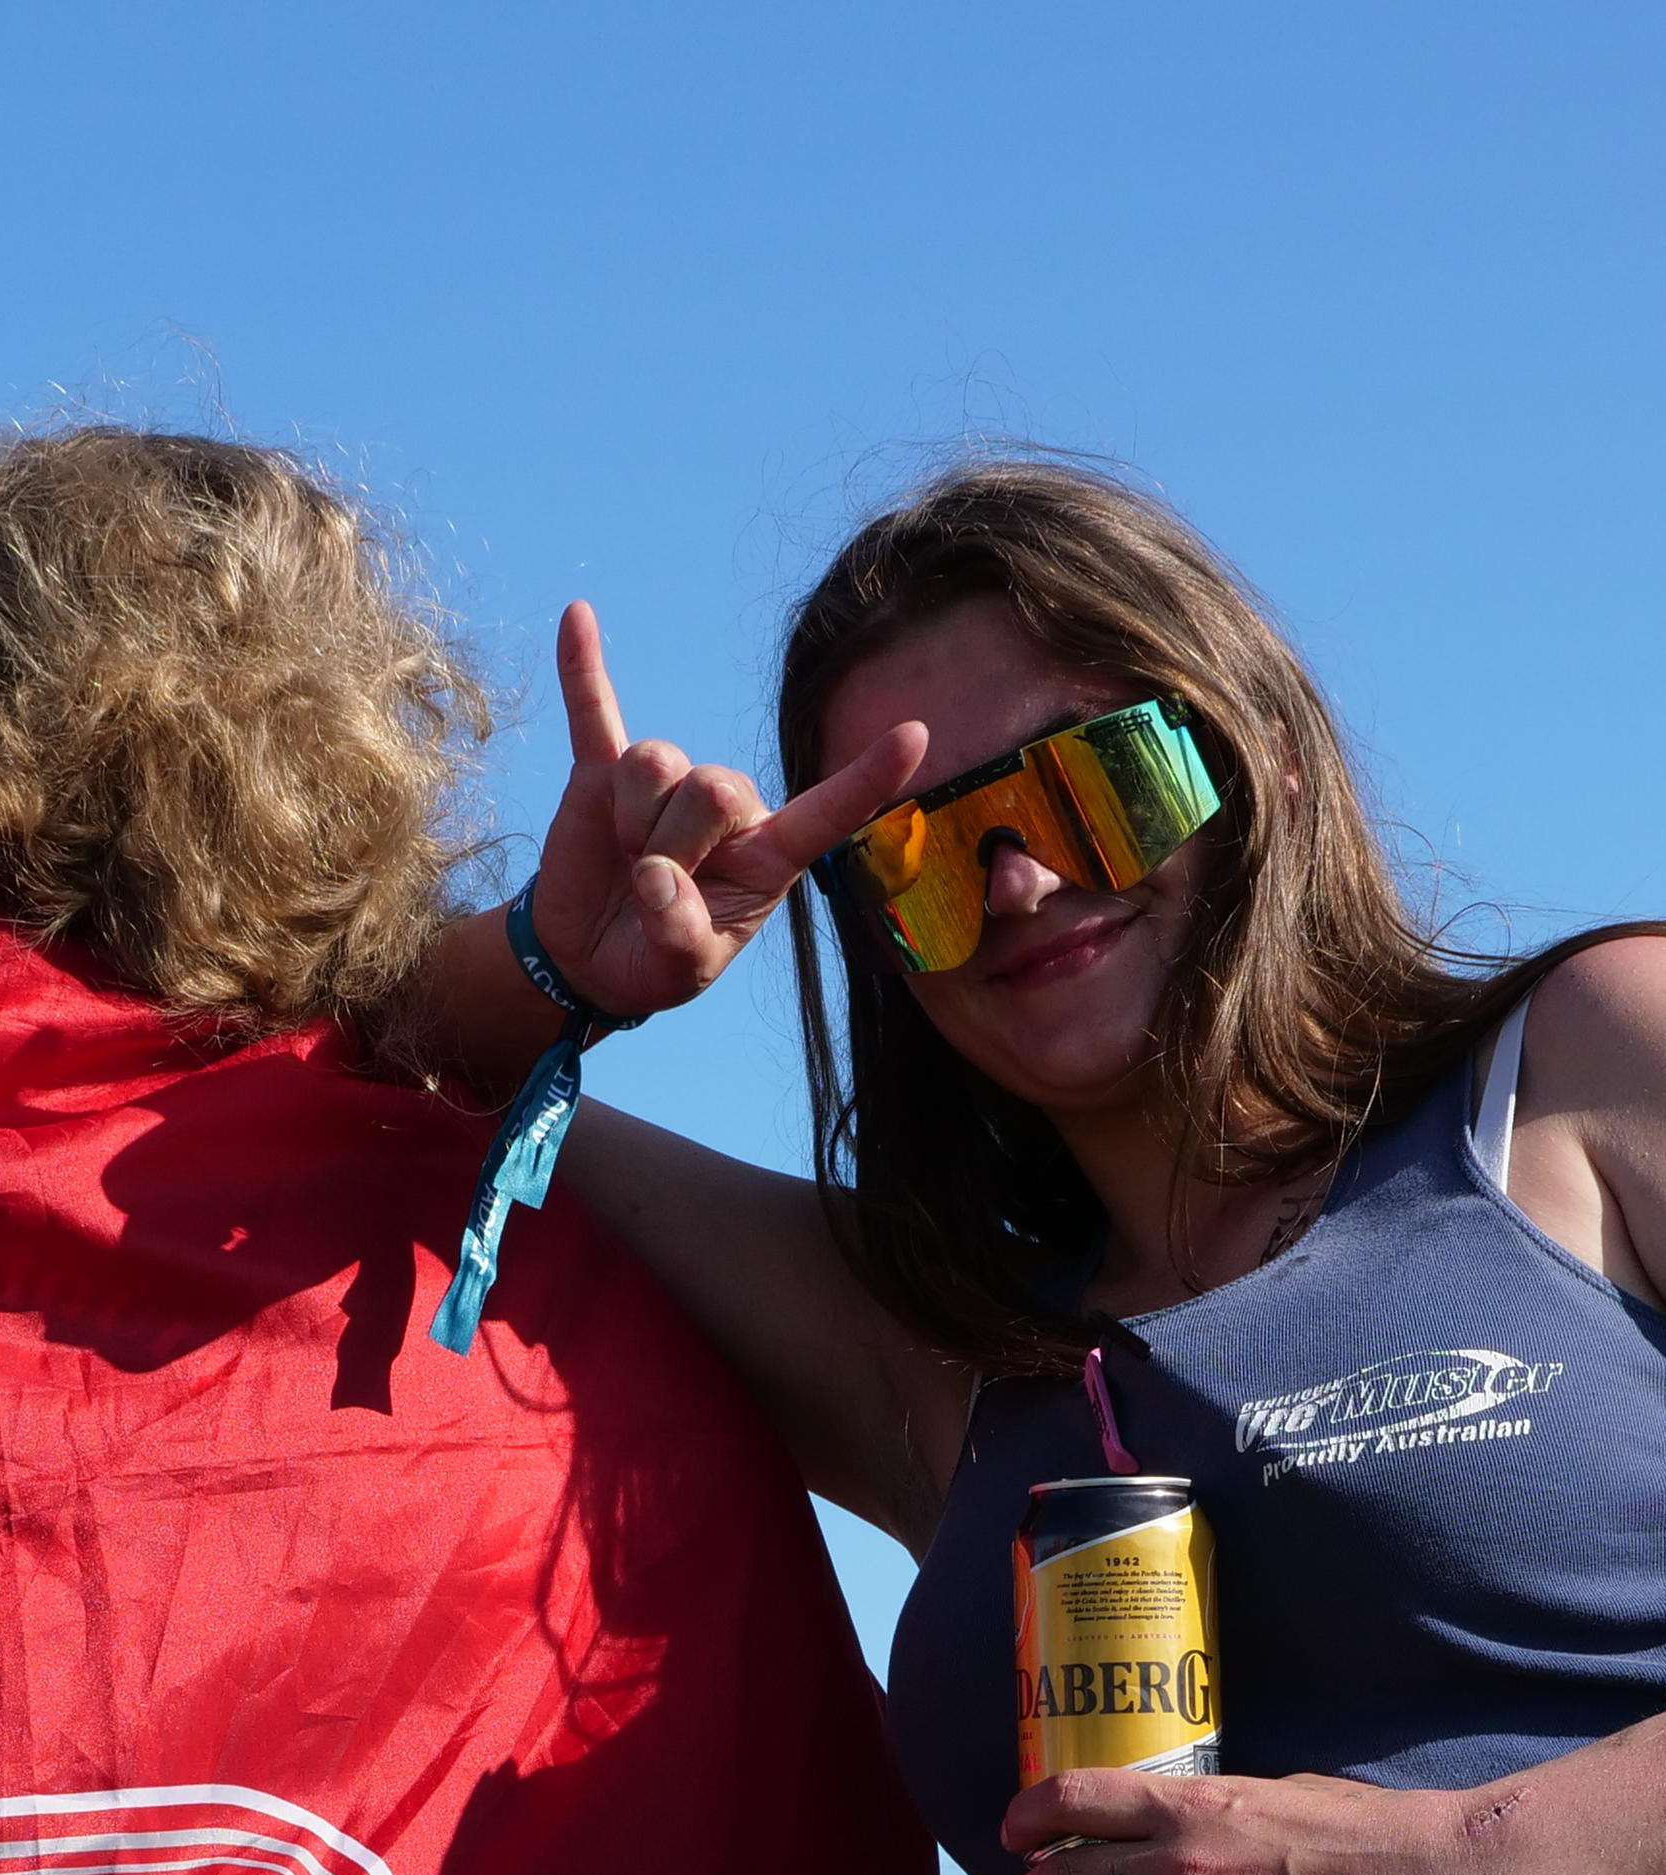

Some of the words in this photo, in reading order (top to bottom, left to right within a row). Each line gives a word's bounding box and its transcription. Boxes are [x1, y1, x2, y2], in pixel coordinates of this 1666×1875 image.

[532, 1064, 574, 1144] ADULT
[1331, 1362, 1563, 1423] Muster
[1263, 1440, 1365, 1487] proudly
[1375, 1417, 1531, 1455] Australian
[1105, 1556, 1140, 1567] 1942
